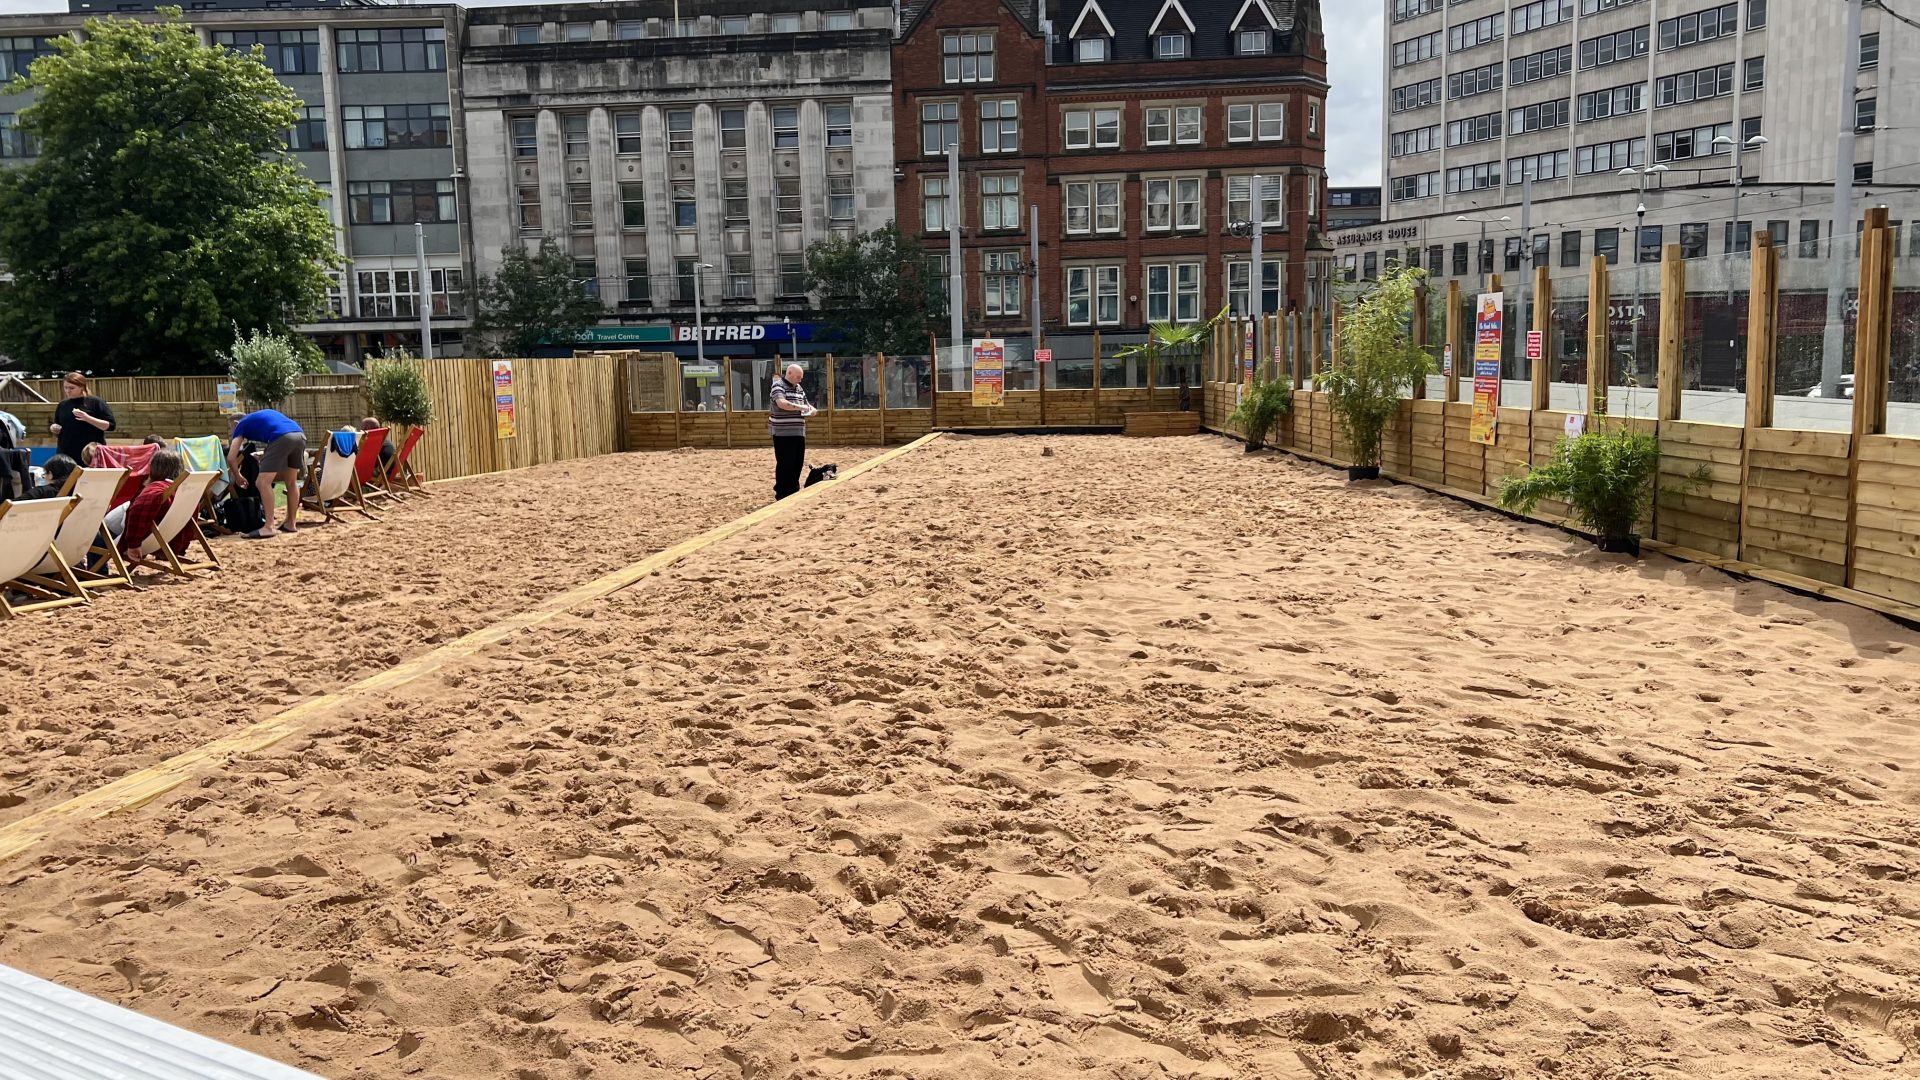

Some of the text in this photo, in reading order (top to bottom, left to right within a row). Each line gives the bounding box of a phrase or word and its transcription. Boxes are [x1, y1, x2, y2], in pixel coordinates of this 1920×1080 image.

[1337, 230, 1383, 246] ASSURANCE
[1388, 226, 1417, 240] HOUSE
[1608, 305, 1646, 319] OSTA
[678, 325, 766, 341] BETFRED
